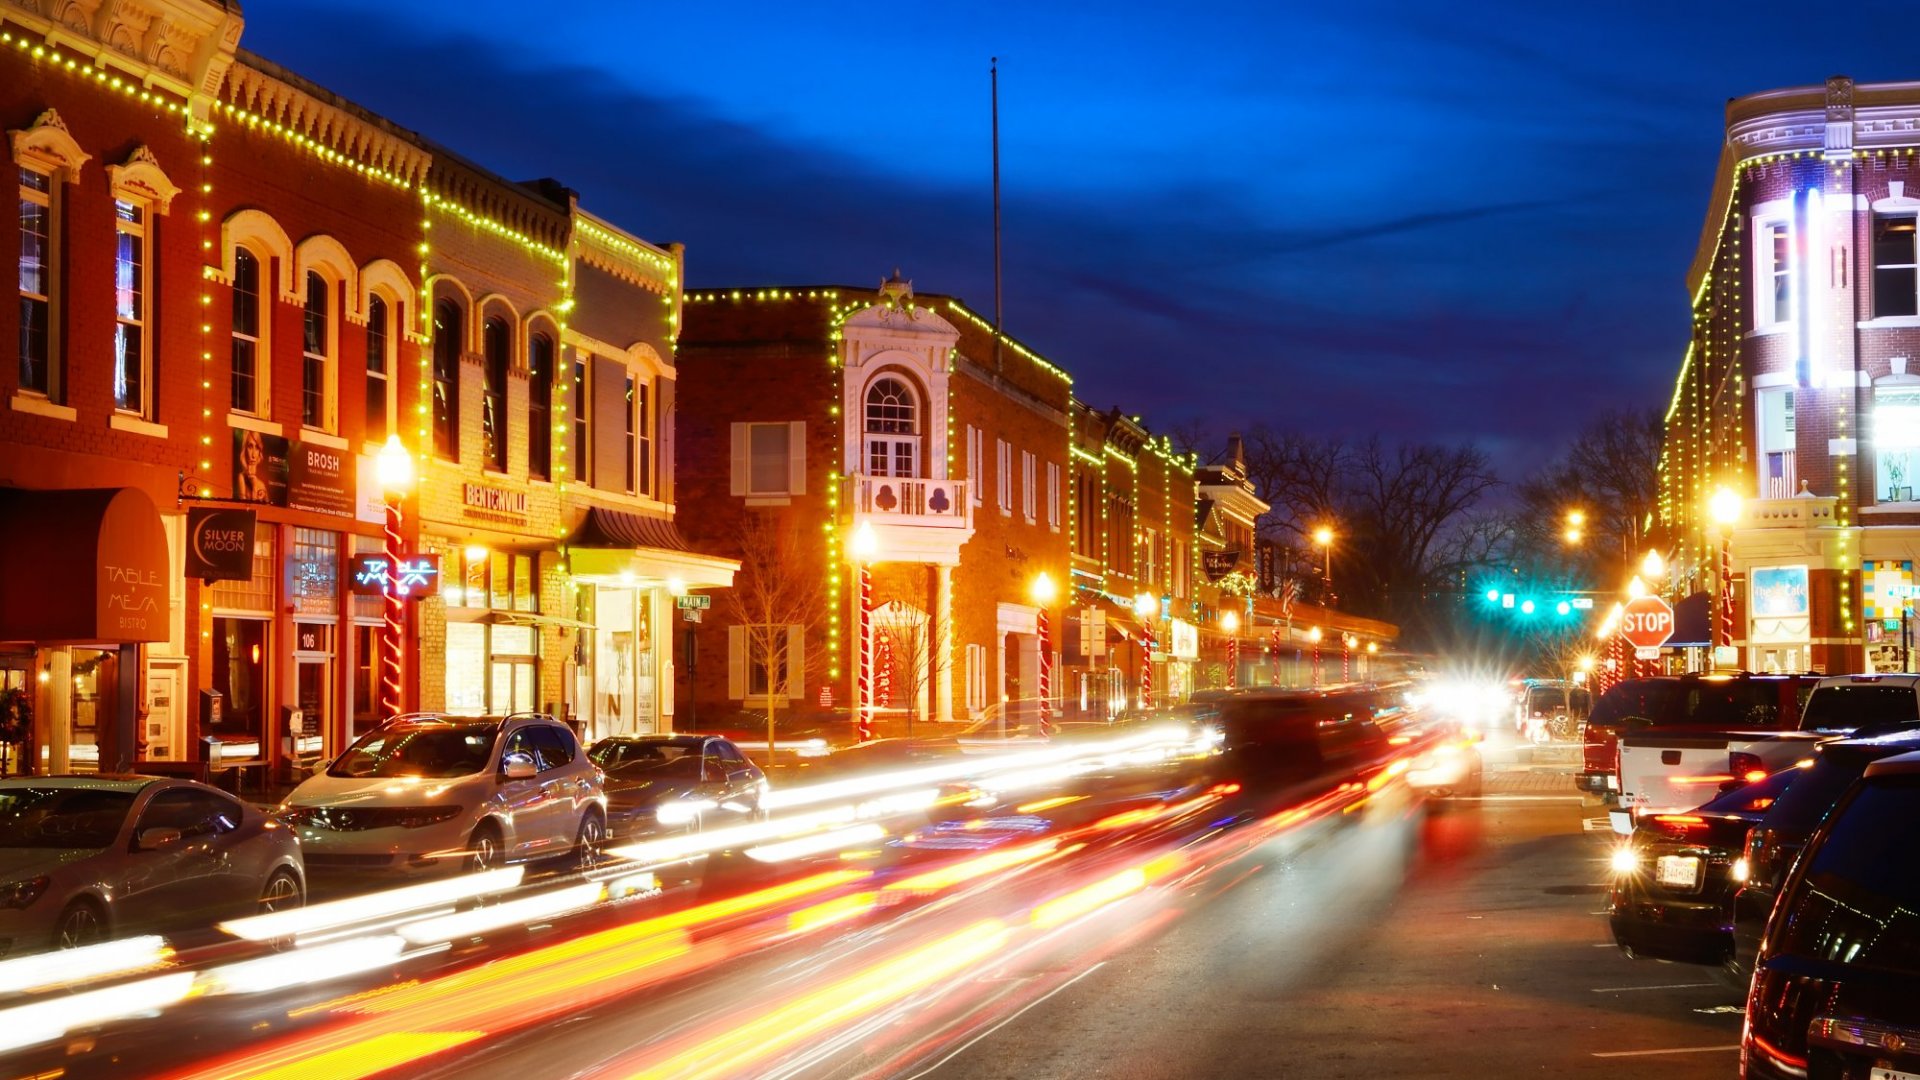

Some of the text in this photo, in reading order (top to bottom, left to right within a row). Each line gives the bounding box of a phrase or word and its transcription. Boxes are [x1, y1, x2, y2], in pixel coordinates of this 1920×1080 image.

[307, 451, 339, 471] BROSH
[204, 529, 245, 541] SILVER
[204, 541, 245, 551] MOON
[104, 565, 163, 587] TABLE
[108, 594, 159, 613] MESA
[683, 596, 701, 607] MAIN
[119, 617, 147, 630] BISTRO
[1624, 612, 1670, 632] STOP
[302, 633, 315, 648] 106
